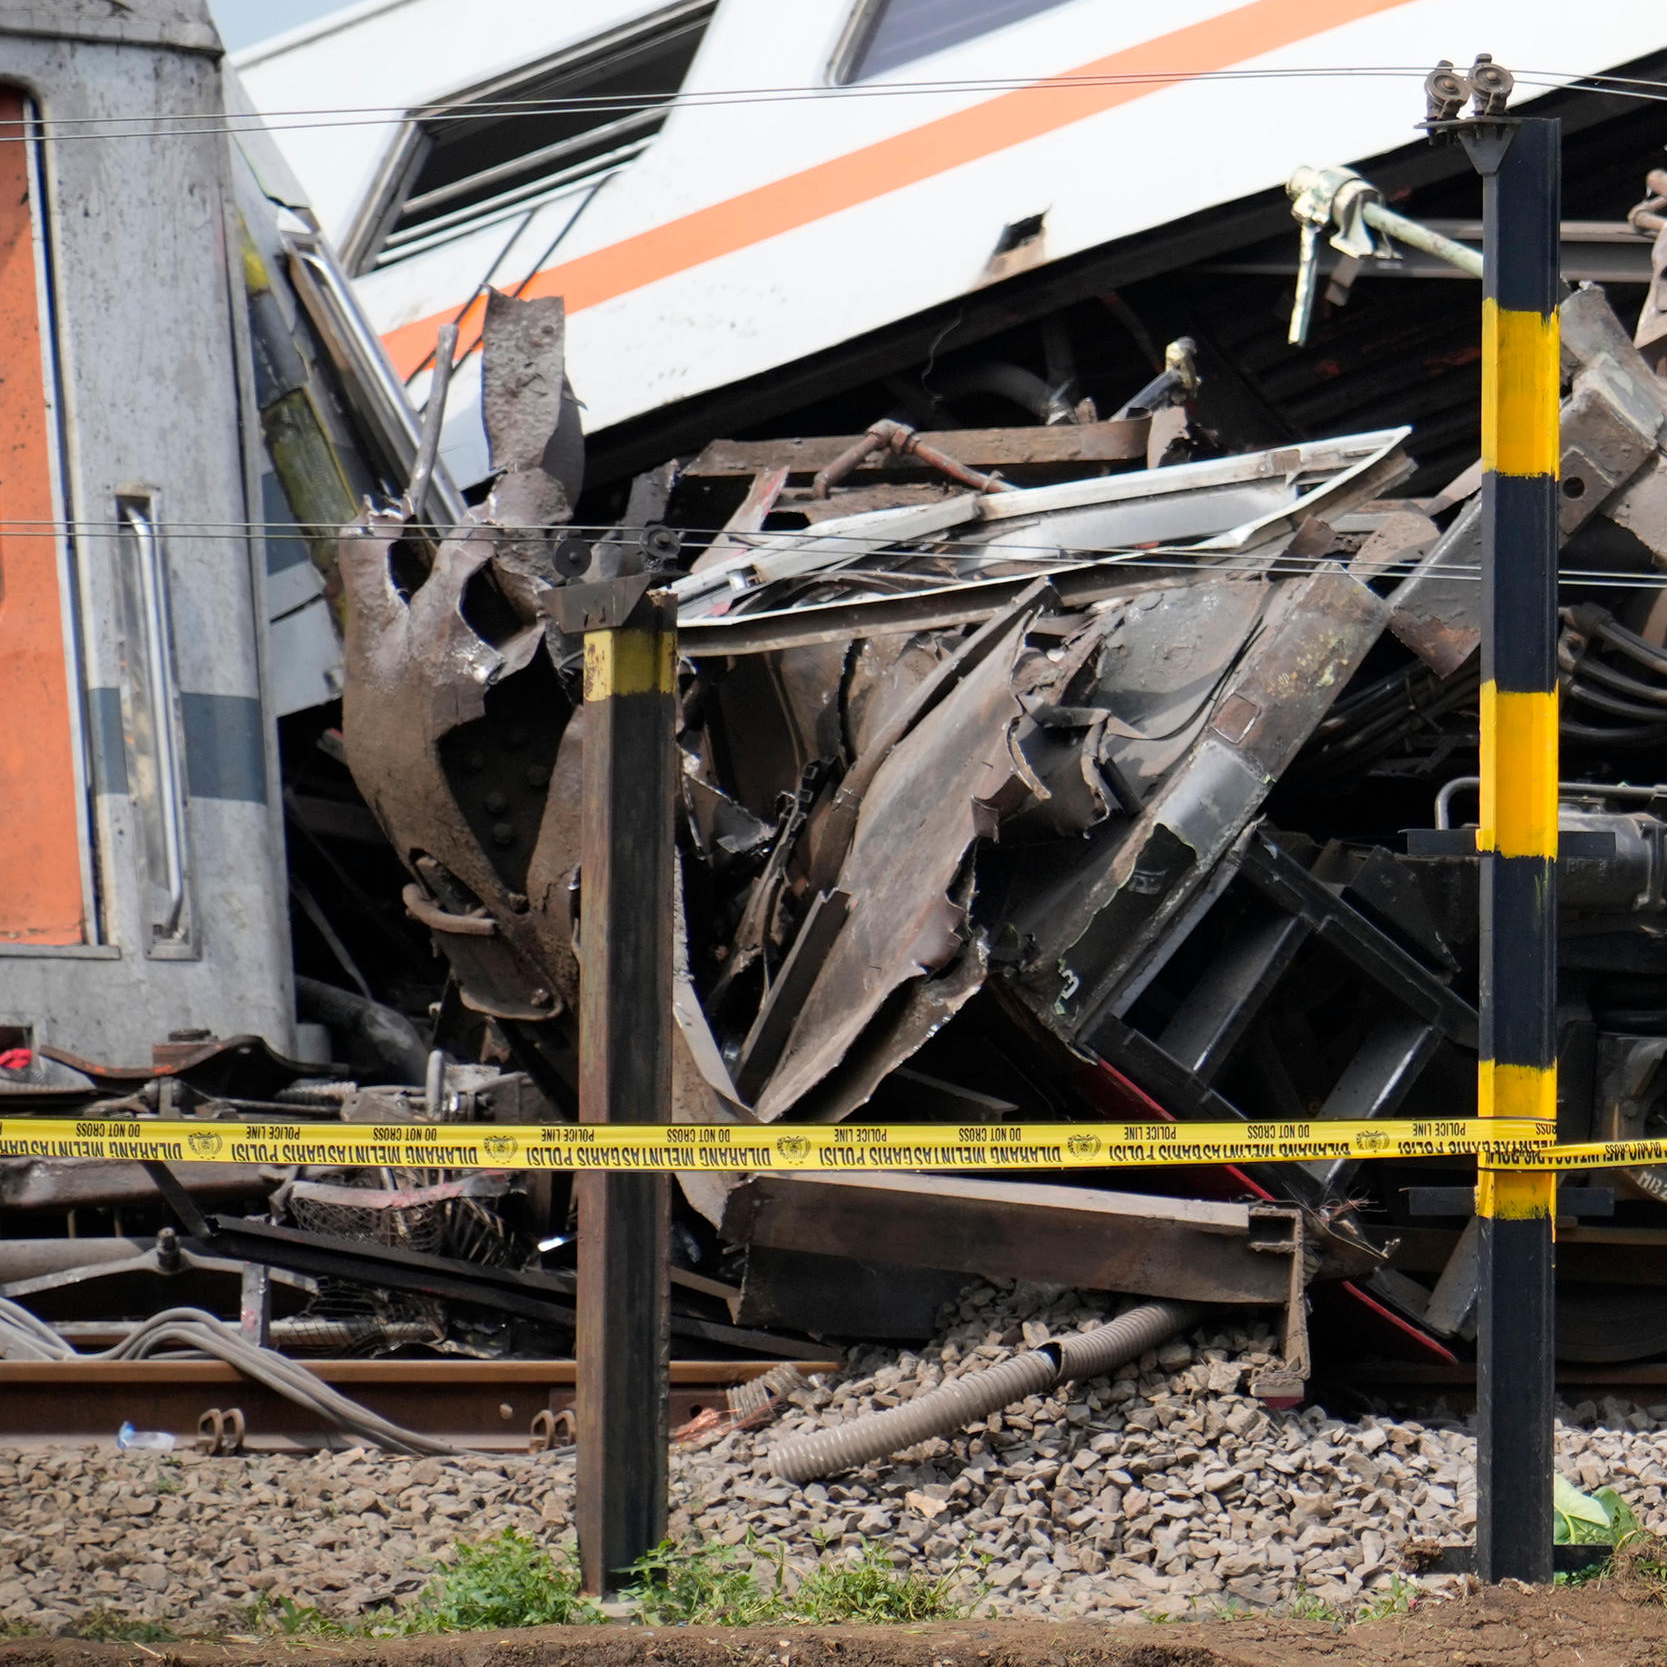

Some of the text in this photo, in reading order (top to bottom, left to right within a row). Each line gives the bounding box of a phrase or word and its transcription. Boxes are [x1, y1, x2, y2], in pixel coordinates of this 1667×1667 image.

[76, 1123, 140, 1137] DO NOT CROSS
[247, 1126, 300, 1140] POLICE LINE
[374, 1128, 436, 1141] DO NOT CROSS
[542, 1129, 594, 1142] POLICE LINE
[667, 1128, 730, 1142] DO NOT CROSS
[834, 1128, 887, 1142] POLICE LINE
[959, 1127, 1021, 1141] DO NOT CROSS
[1124, 1127, 1176, 1140] POLICE LINE
[1248, 1125, 1309, 1139] DO NOT CROSS
[1413, 1123, 1465, 1136] POLICE LINE
[1536, 1123, 1556, 1135] ROSS
[110, 1141, 182, 1160] DILARANG
[231, 1144, 277, 1162] POLISI
[406, 1146, 478, 1165] DILARANG
[526, 1147, 571, 1166] POLISI
[700, 1147, 771, 1167] DILARANG
[819, 1147, 864, 1165] POLISI
[990, 1146, 1062, 1163] DILARANG
[1109, 1146, 1154, 1162] POLISI
